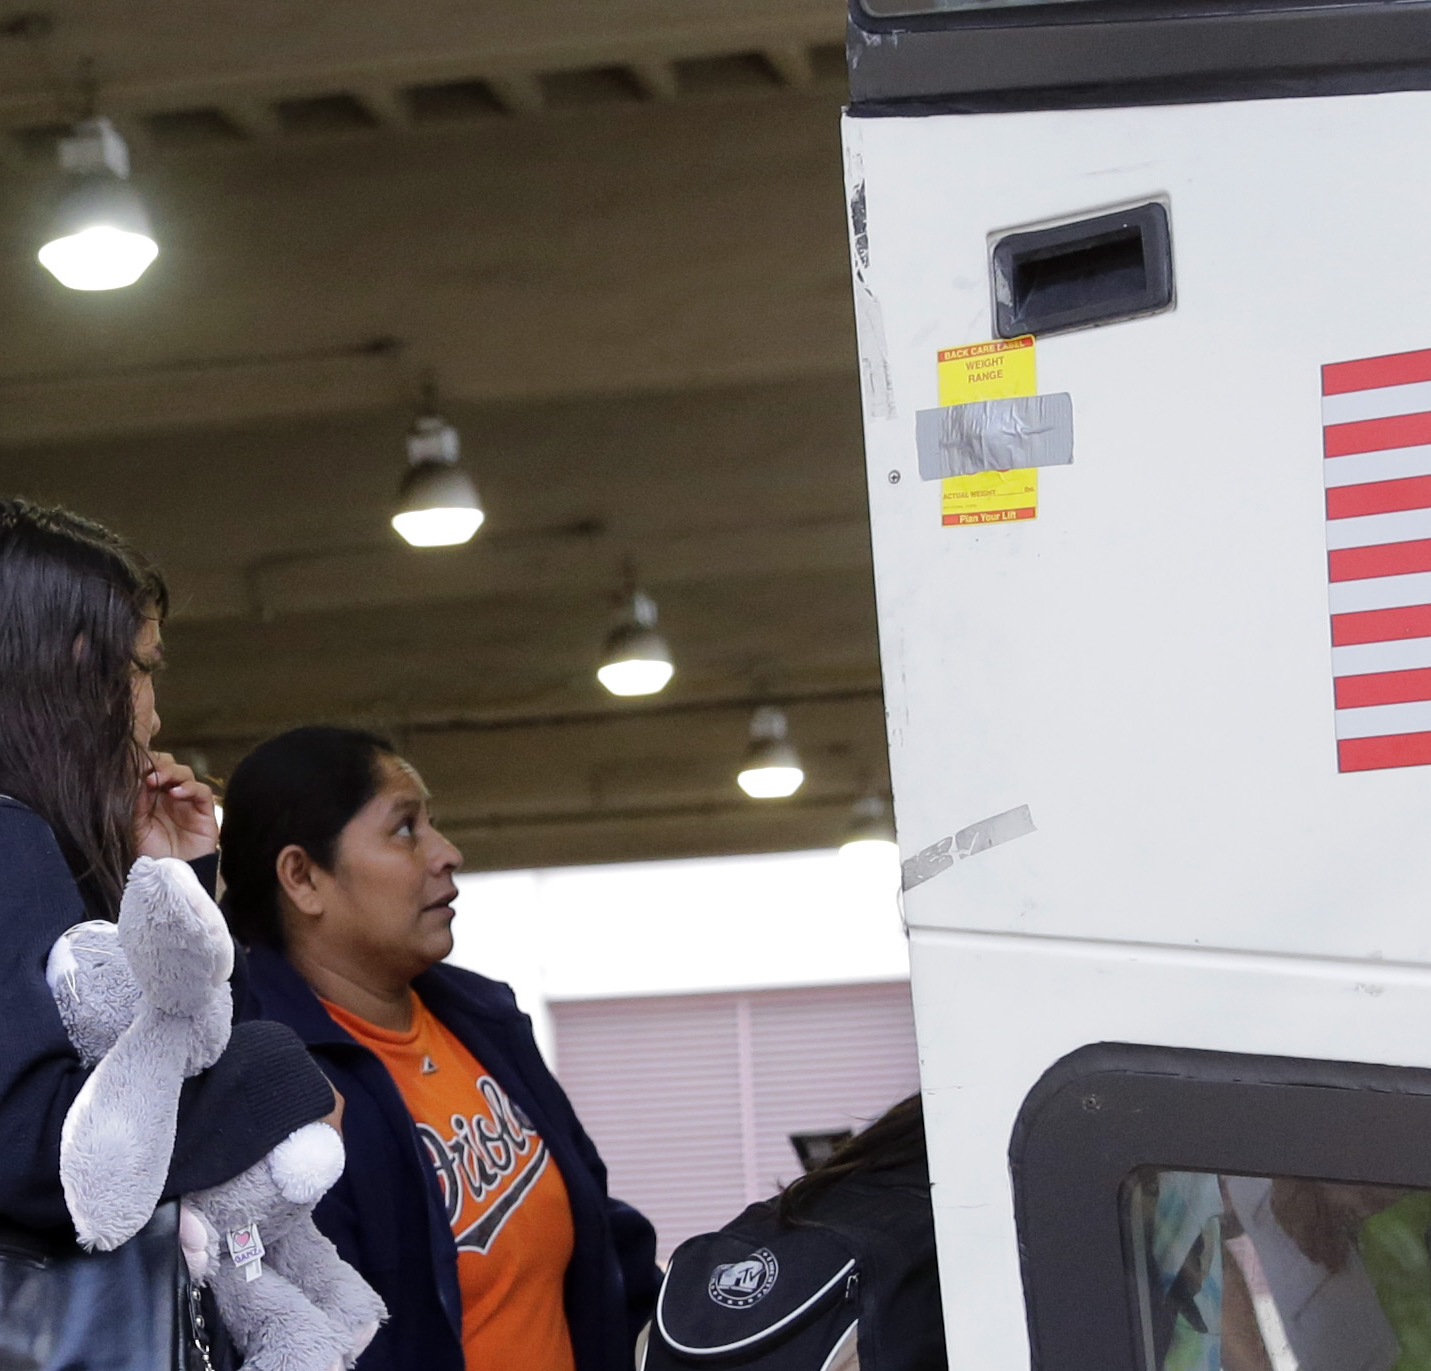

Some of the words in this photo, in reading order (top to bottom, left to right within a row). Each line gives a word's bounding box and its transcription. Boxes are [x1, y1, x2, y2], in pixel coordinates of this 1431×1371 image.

[944, 349, 969, 360] BACK
[971, 344, 996, 356] CARE
[997, 340, 1026, 352] LABEL
[966, 356, 1005, 370] WEIGHT
[968, 370, 1003, 383] RANGE
[943, 492, 969, 500] ACTUAL
[970, 489, 996, 497] WEIGHT
[959, 514, 979, 524] Plan
[980, 512, 1001, 522] Your
[1002, 511, 1017, 520] Lift
